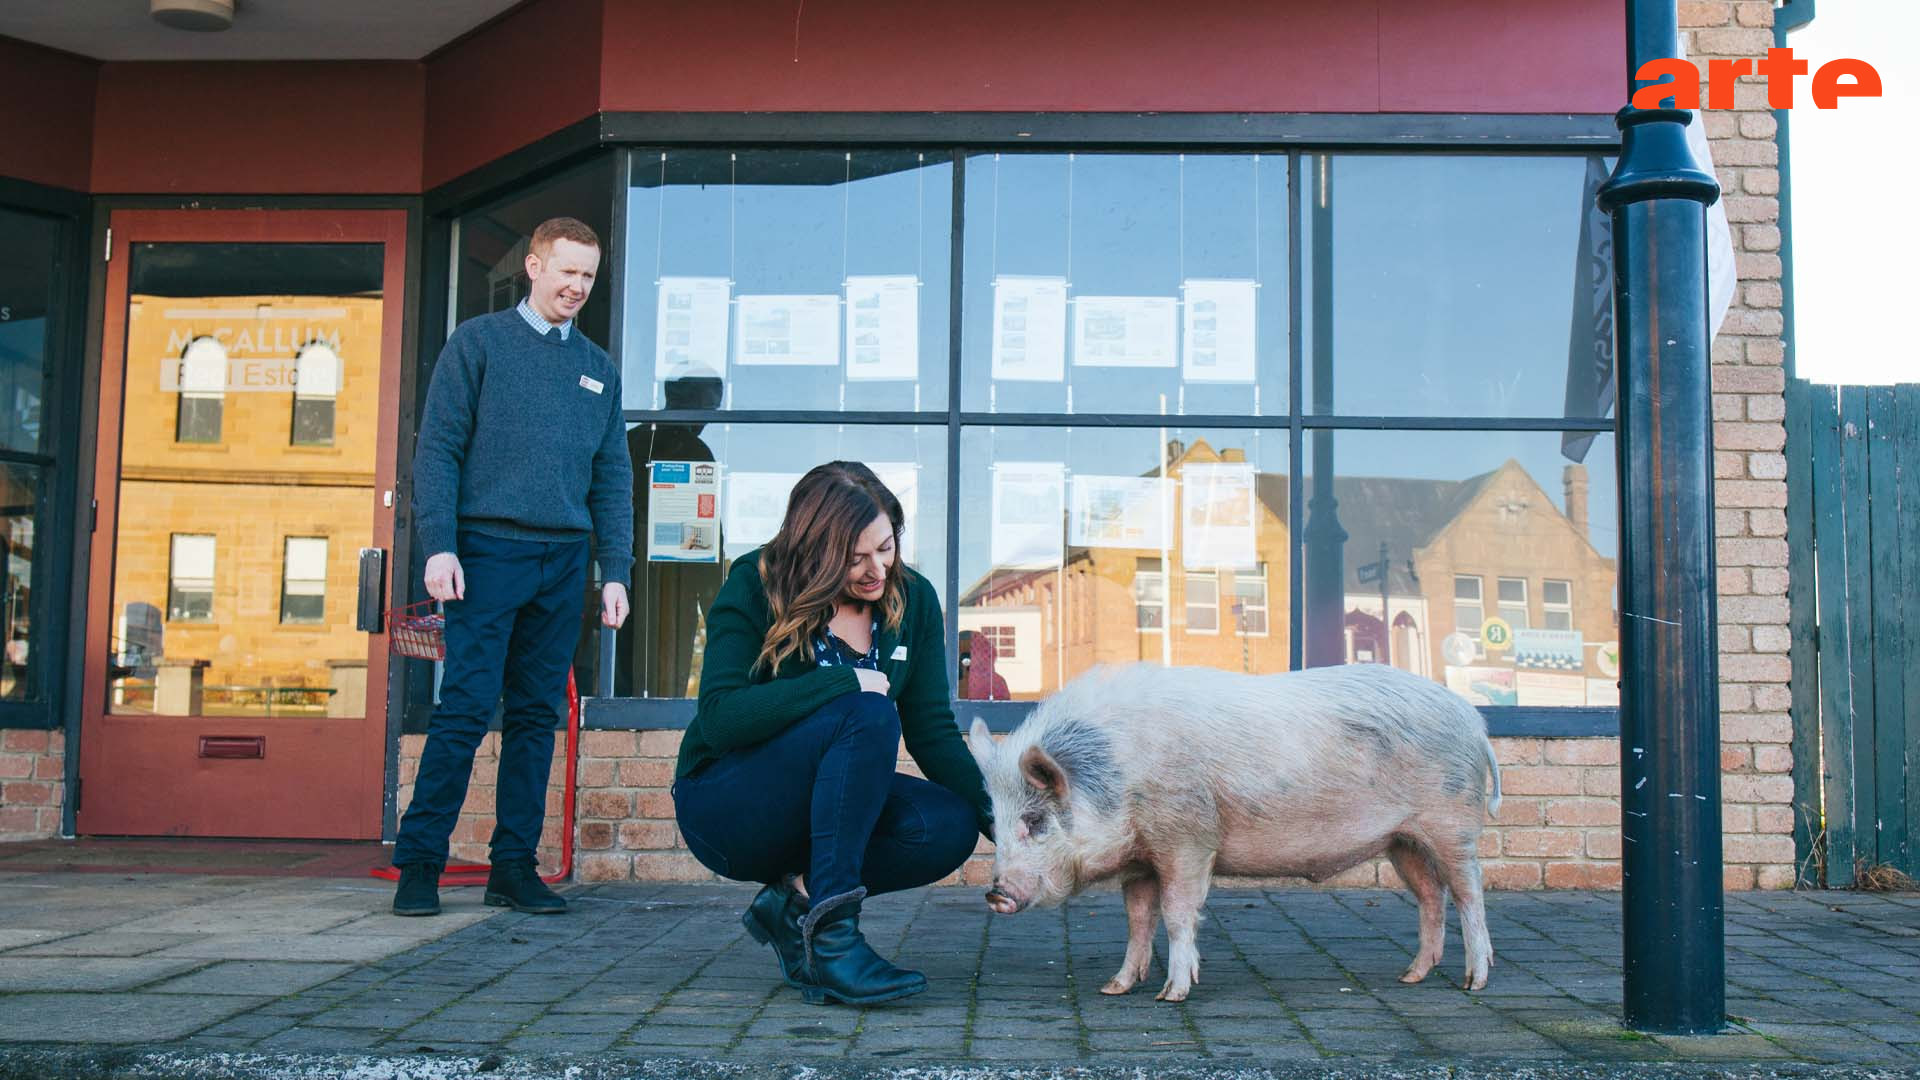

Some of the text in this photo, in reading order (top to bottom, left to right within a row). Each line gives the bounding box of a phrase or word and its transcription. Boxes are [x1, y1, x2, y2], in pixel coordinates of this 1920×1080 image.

[166, 327, 342, 353] MCALLUM
[178, 363, 335, 385] eal Esta
